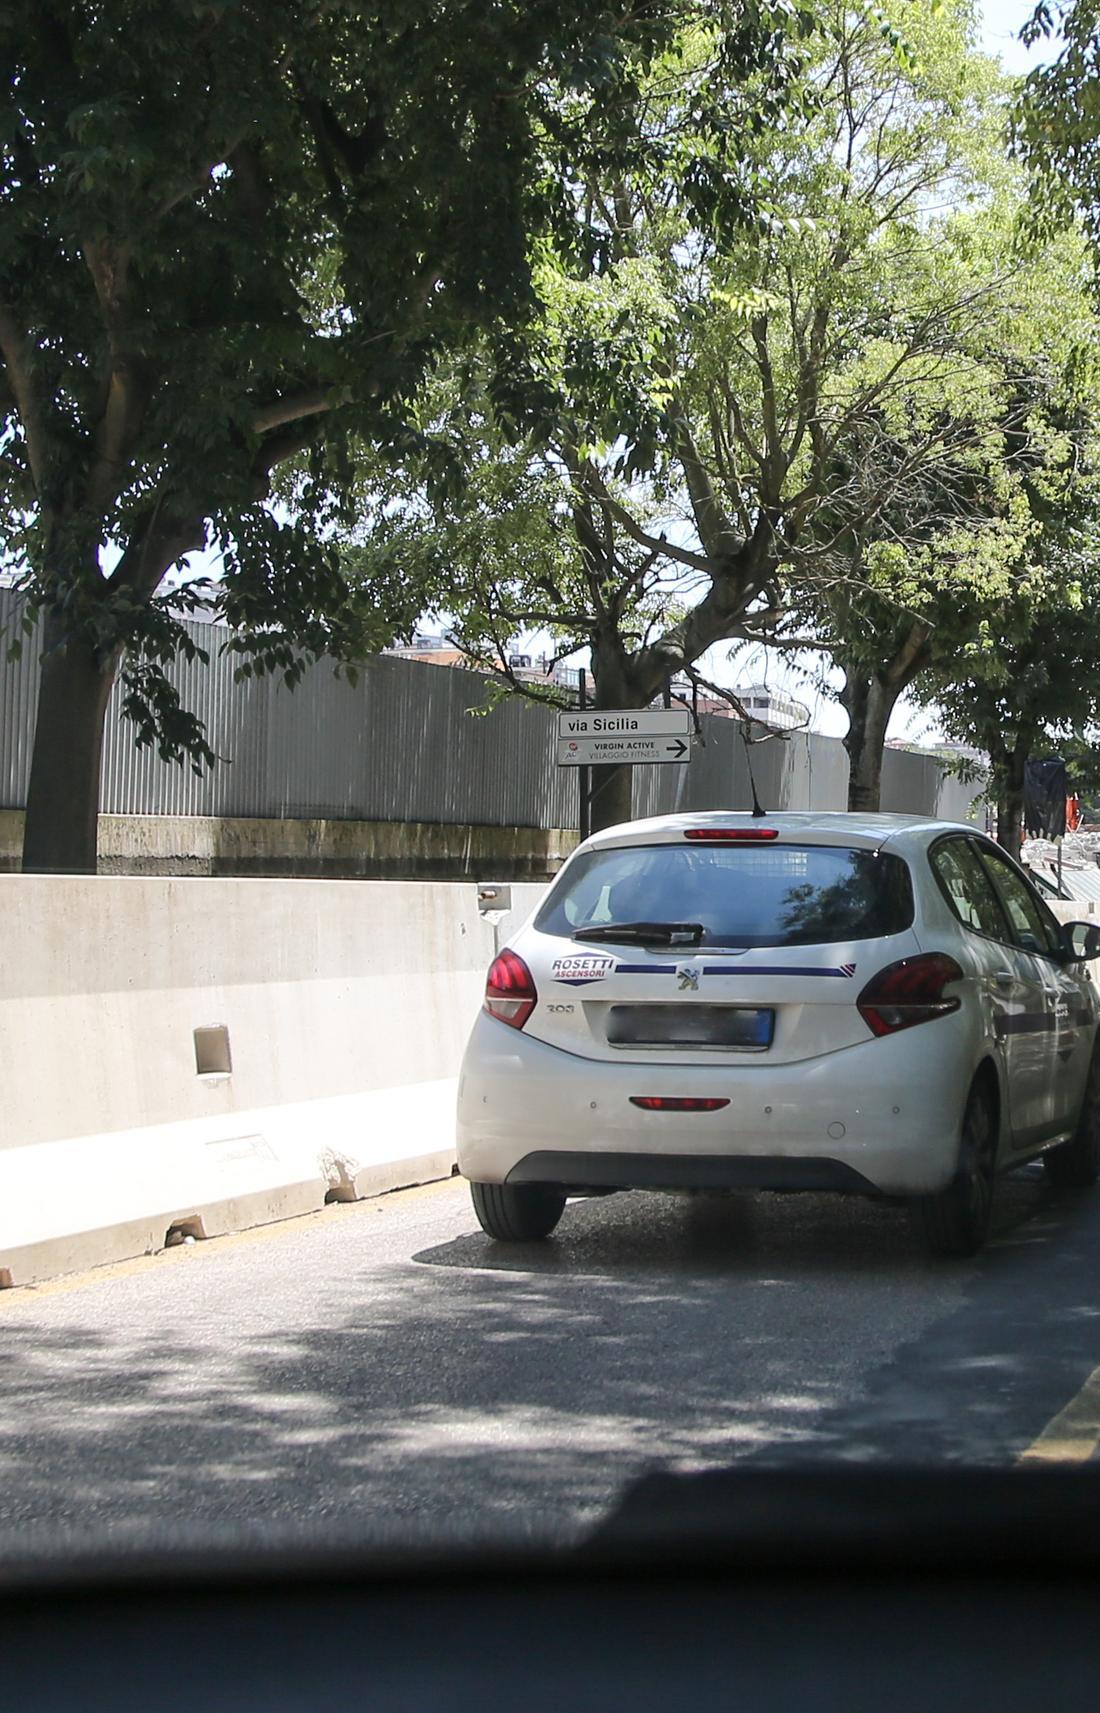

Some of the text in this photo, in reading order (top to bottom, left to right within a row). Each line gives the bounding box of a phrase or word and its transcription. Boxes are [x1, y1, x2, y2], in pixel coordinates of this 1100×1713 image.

[568, 718, 639, 732] via Sicilia
[594, 741, 655, 751] VIRGIN ACTIVE
[588, 749, 660, 760] VILLAGGIO FITNESS
[552, 959, 614, 970] ROSETTI
[554, 970, 606, 978] ASCENSORI
